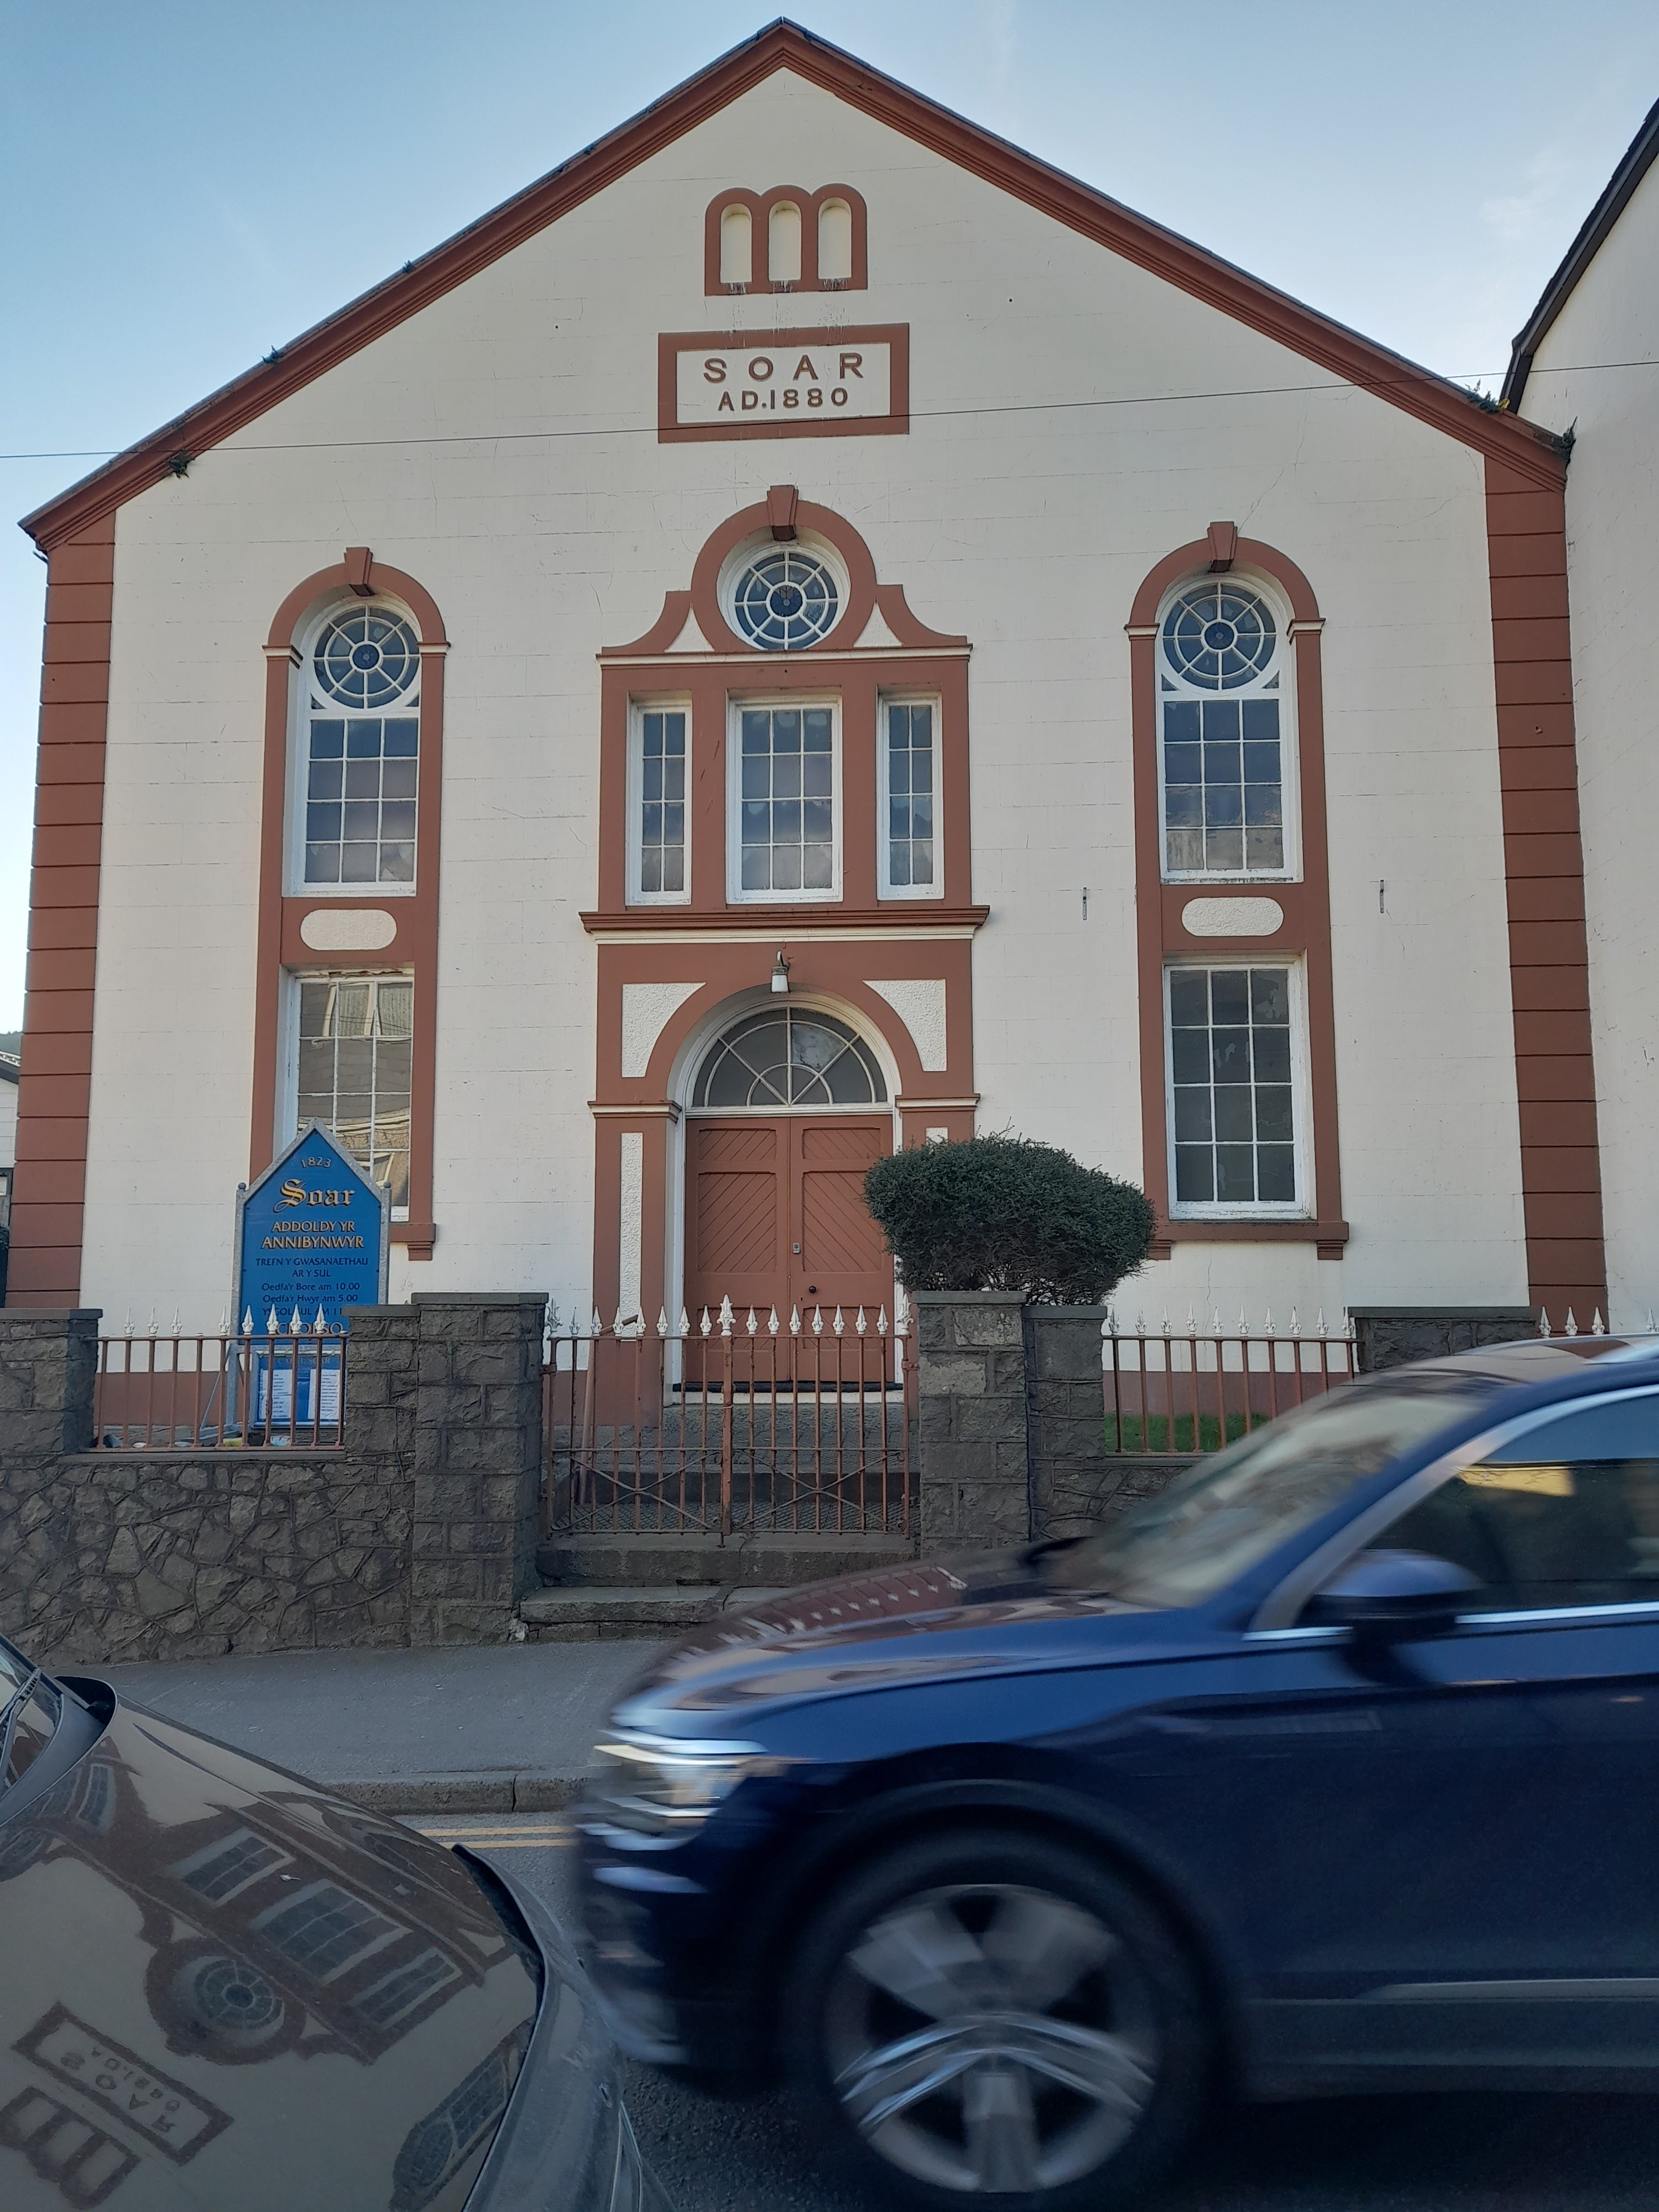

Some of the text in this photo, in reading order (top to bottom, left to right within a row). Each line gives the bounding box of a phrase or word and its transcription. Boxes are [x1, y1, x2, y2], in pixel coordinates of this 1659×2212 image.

[703, 352, 863, 383] SOAR
[717, 387, 848, 411] AD.1880
[301, 1156, 332, 1168] 1823
[273, 1178, 356, 1213] Soar
[271, 1220, 356, 1233] ADDOLDY YR
[261, 1235, 364, 1249] ANNIBYNWYR
[294, 1258, 368, 1266] GWASANAETHAU
[298, 1295, 320, 1304] Hwyr
